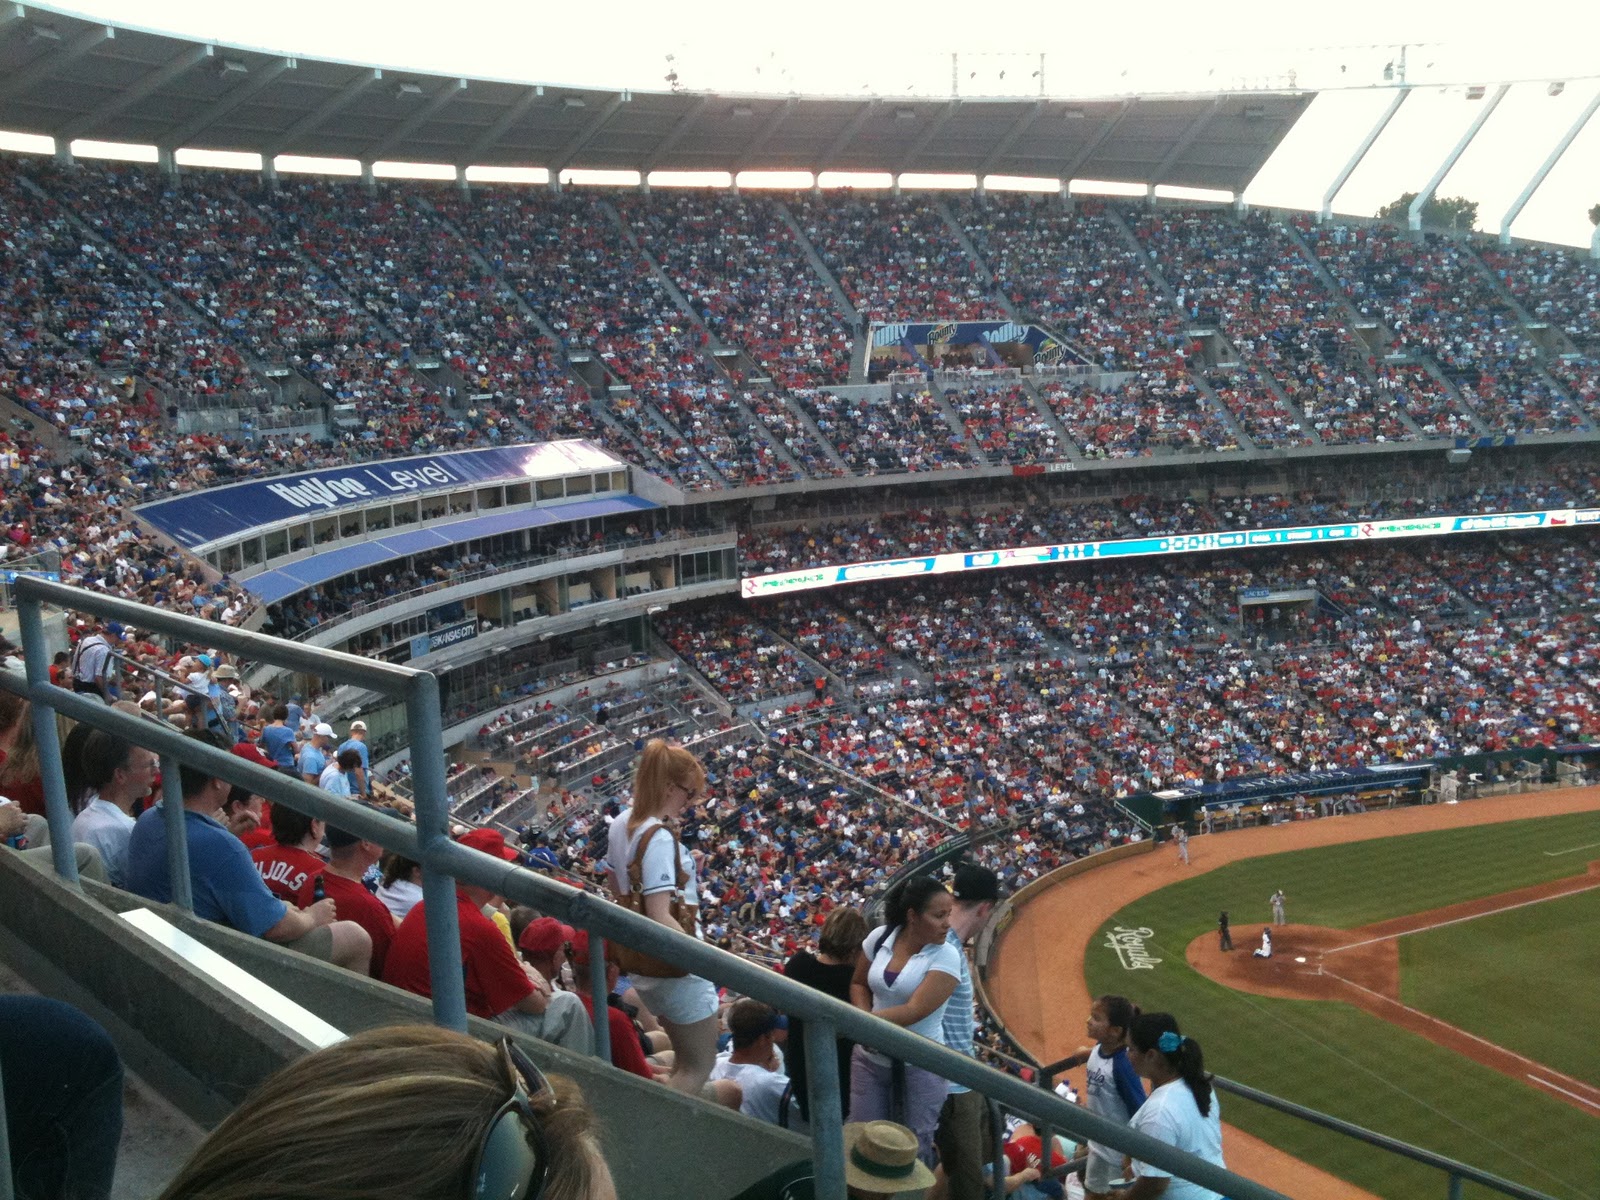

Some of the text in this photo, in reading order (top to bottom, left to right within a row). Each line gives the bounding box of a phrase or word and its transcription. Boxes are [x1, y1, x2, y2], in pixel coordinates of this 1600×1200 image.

[927, 323, 957, 345] Bounty
[1033, 343, 1067, 366] Bounty
[364, 460, 459, 491] Level
[1050, 463, 1077, 472] LEVEL
[461, 624, 476, 638] CITY
[1103, 926, 1163, 971] Royals
